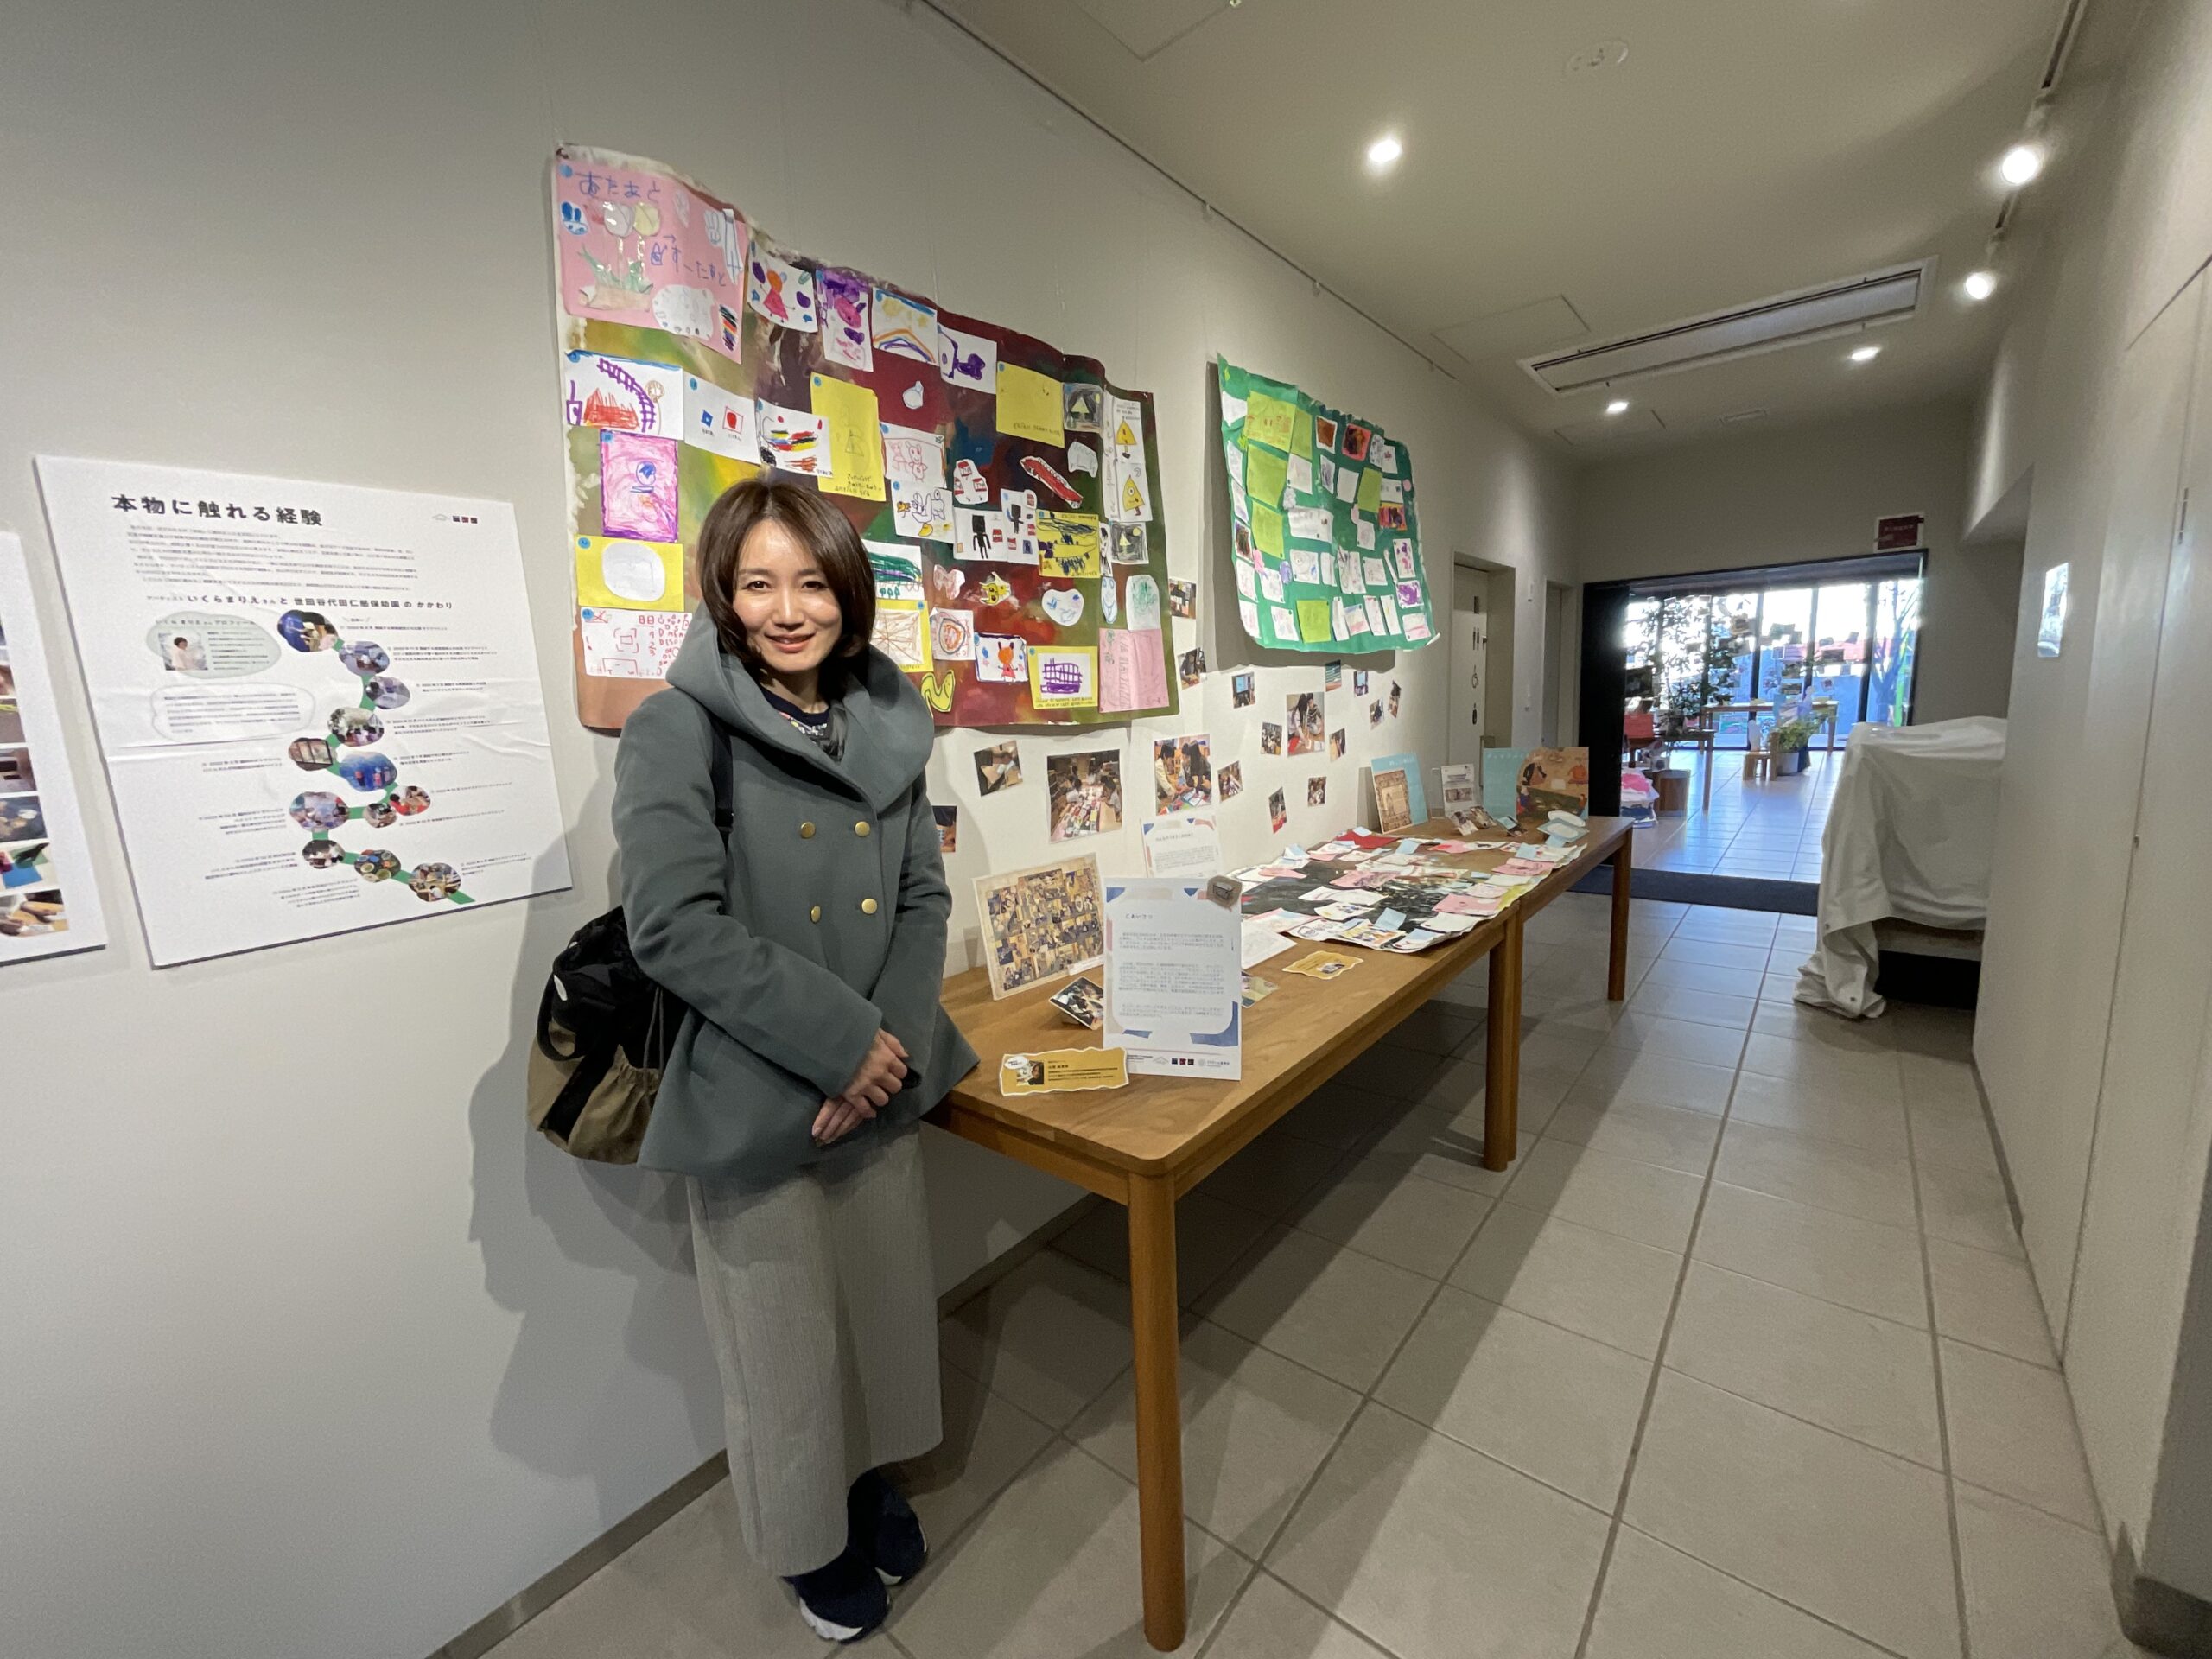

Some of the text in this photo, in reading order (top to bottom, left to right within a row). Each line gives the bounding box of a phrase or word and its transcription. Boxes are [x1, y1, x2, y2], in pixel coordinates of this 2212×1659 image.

[111, 494, 323, 526] 本物に触れる経験
